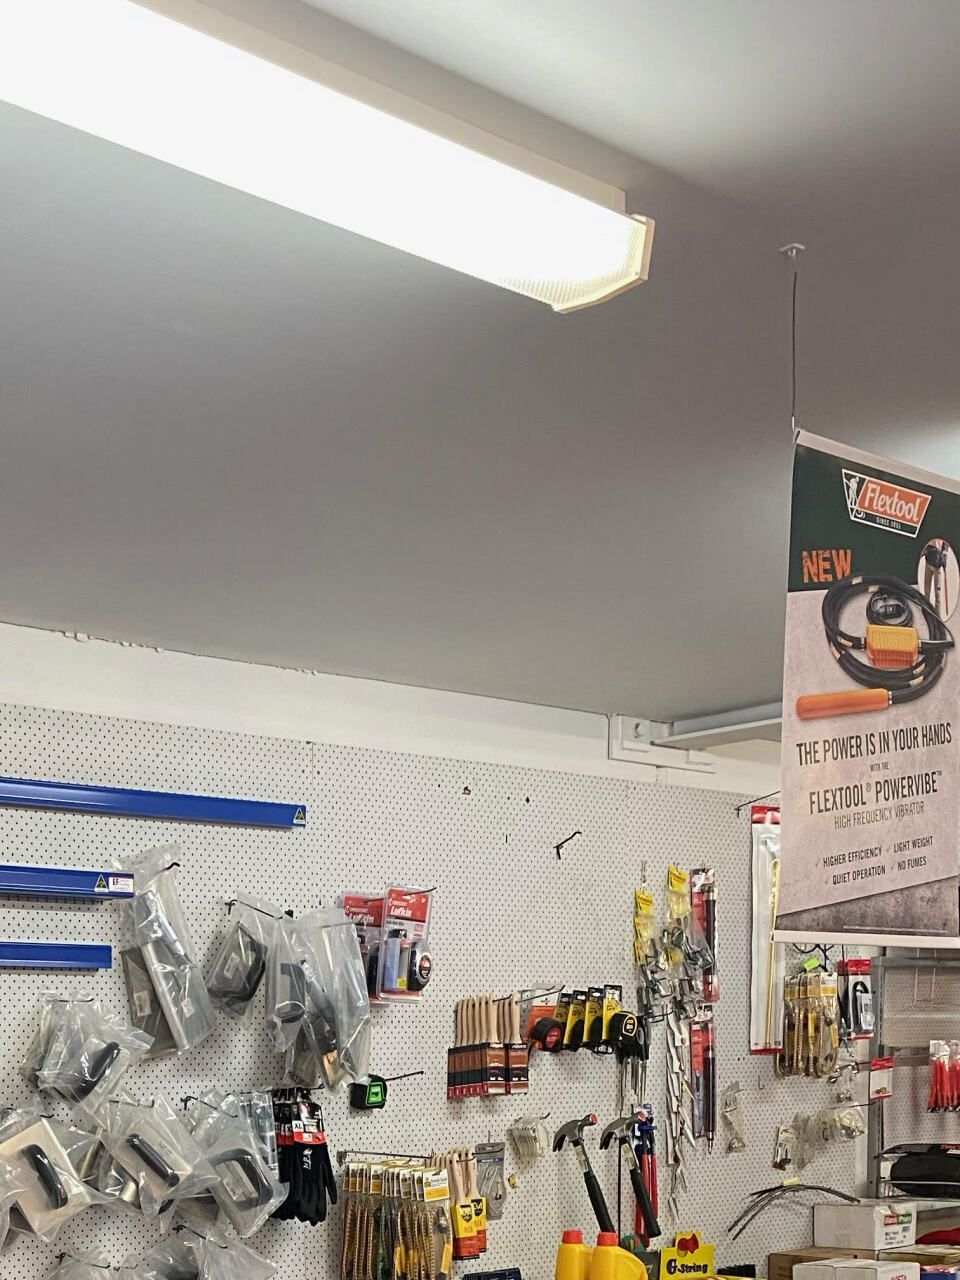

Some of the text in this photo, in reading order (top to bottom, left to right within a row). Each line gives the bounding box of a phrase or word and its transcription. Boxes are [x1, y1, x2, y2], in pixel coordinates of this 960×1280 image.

[864, 483, 919, 522] Flextool
[802, 549, 852, 584] NEW
[796, 722, 952, 766] THE POWER IS IN YOUR HANDS
[870, 762, 889, 773] WITH THE
[834, 801, 925, 829] HIGH FREQUENCY VIBRATOR
[894, 835, 933, 853] LIGHT WEIGHT
[823, 846, 882, 868] HIGHER EFFICIENCY
[897, 856, 927, 871] NO FUMES
[832, 865, 886, 885] QUIET OPERATION
[390, 906, 412, 917] Lufkin
[666, 1259, 708, 1275] G-String
